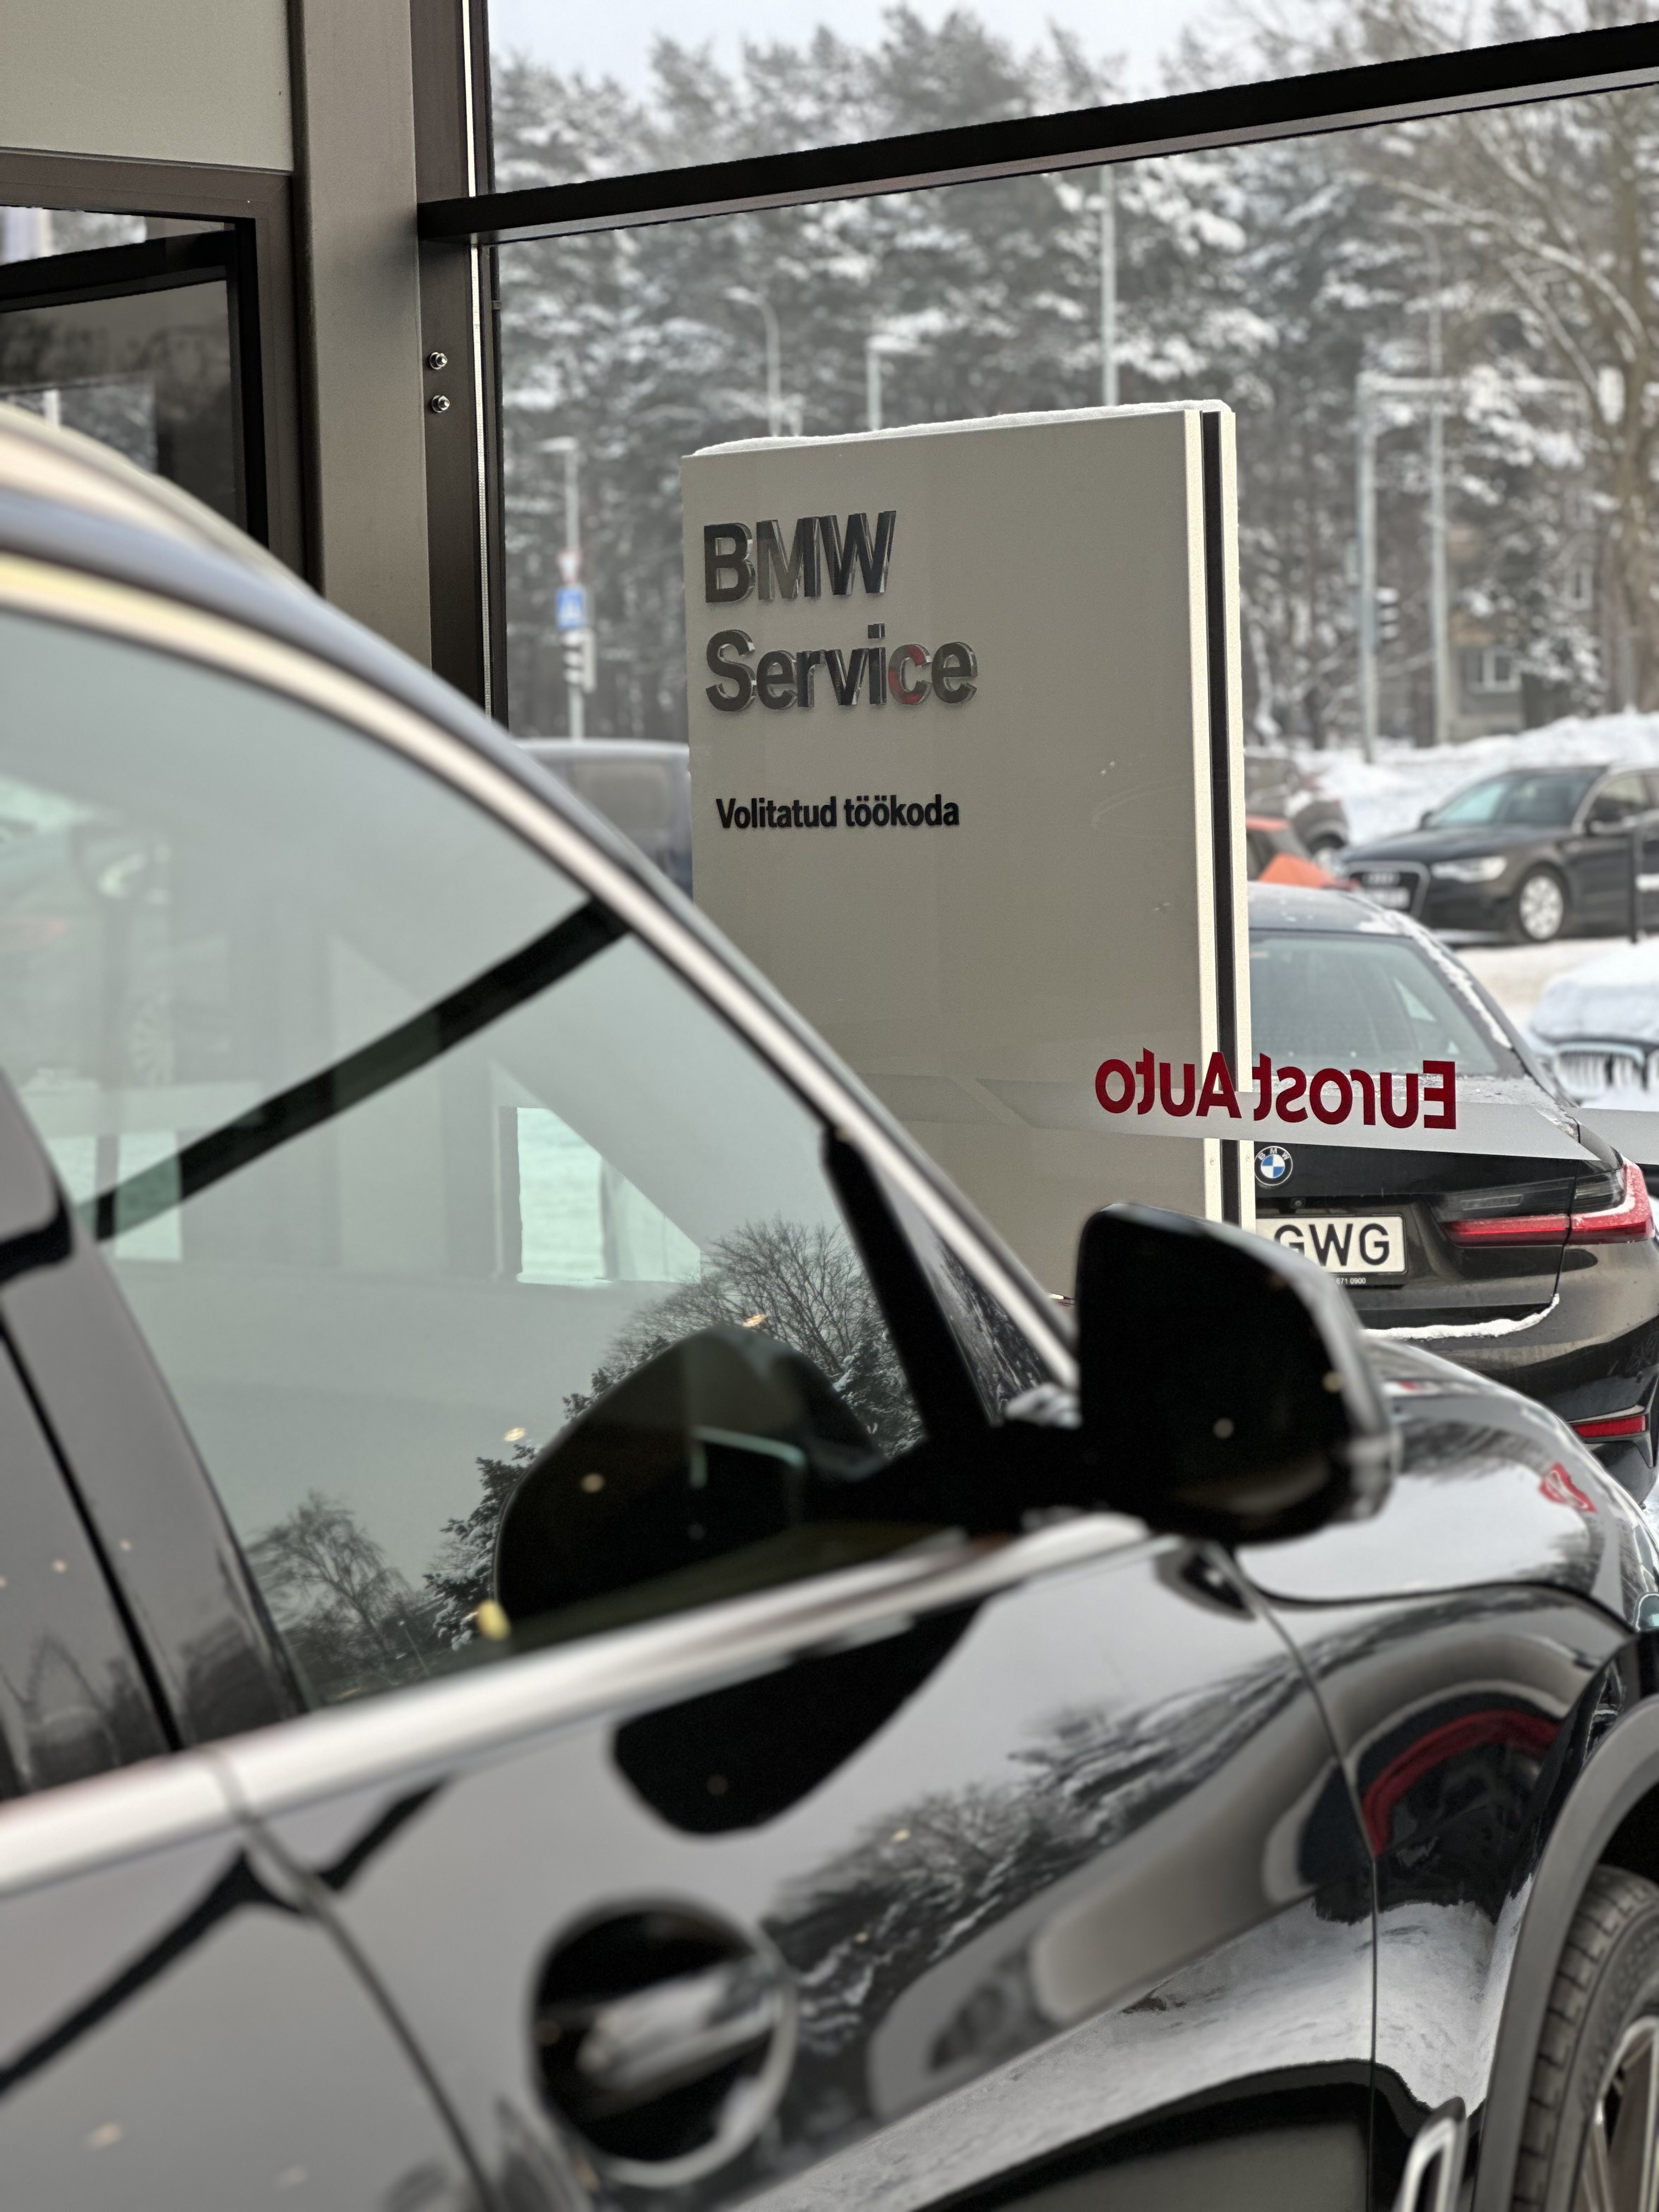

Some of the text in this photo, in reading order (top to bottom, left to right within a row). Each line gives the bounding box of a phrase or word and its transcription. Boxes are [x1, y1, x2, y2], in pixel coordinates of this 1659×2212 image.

[704, 511, 896, 602] BMW
[706, 623, 978, 712] Service
[715, 794, 960, 828] Volitatud töökoda
[1258, 1148, 1290, 1160] BMW
[1274, 1223, 1390, 1267] GWG
